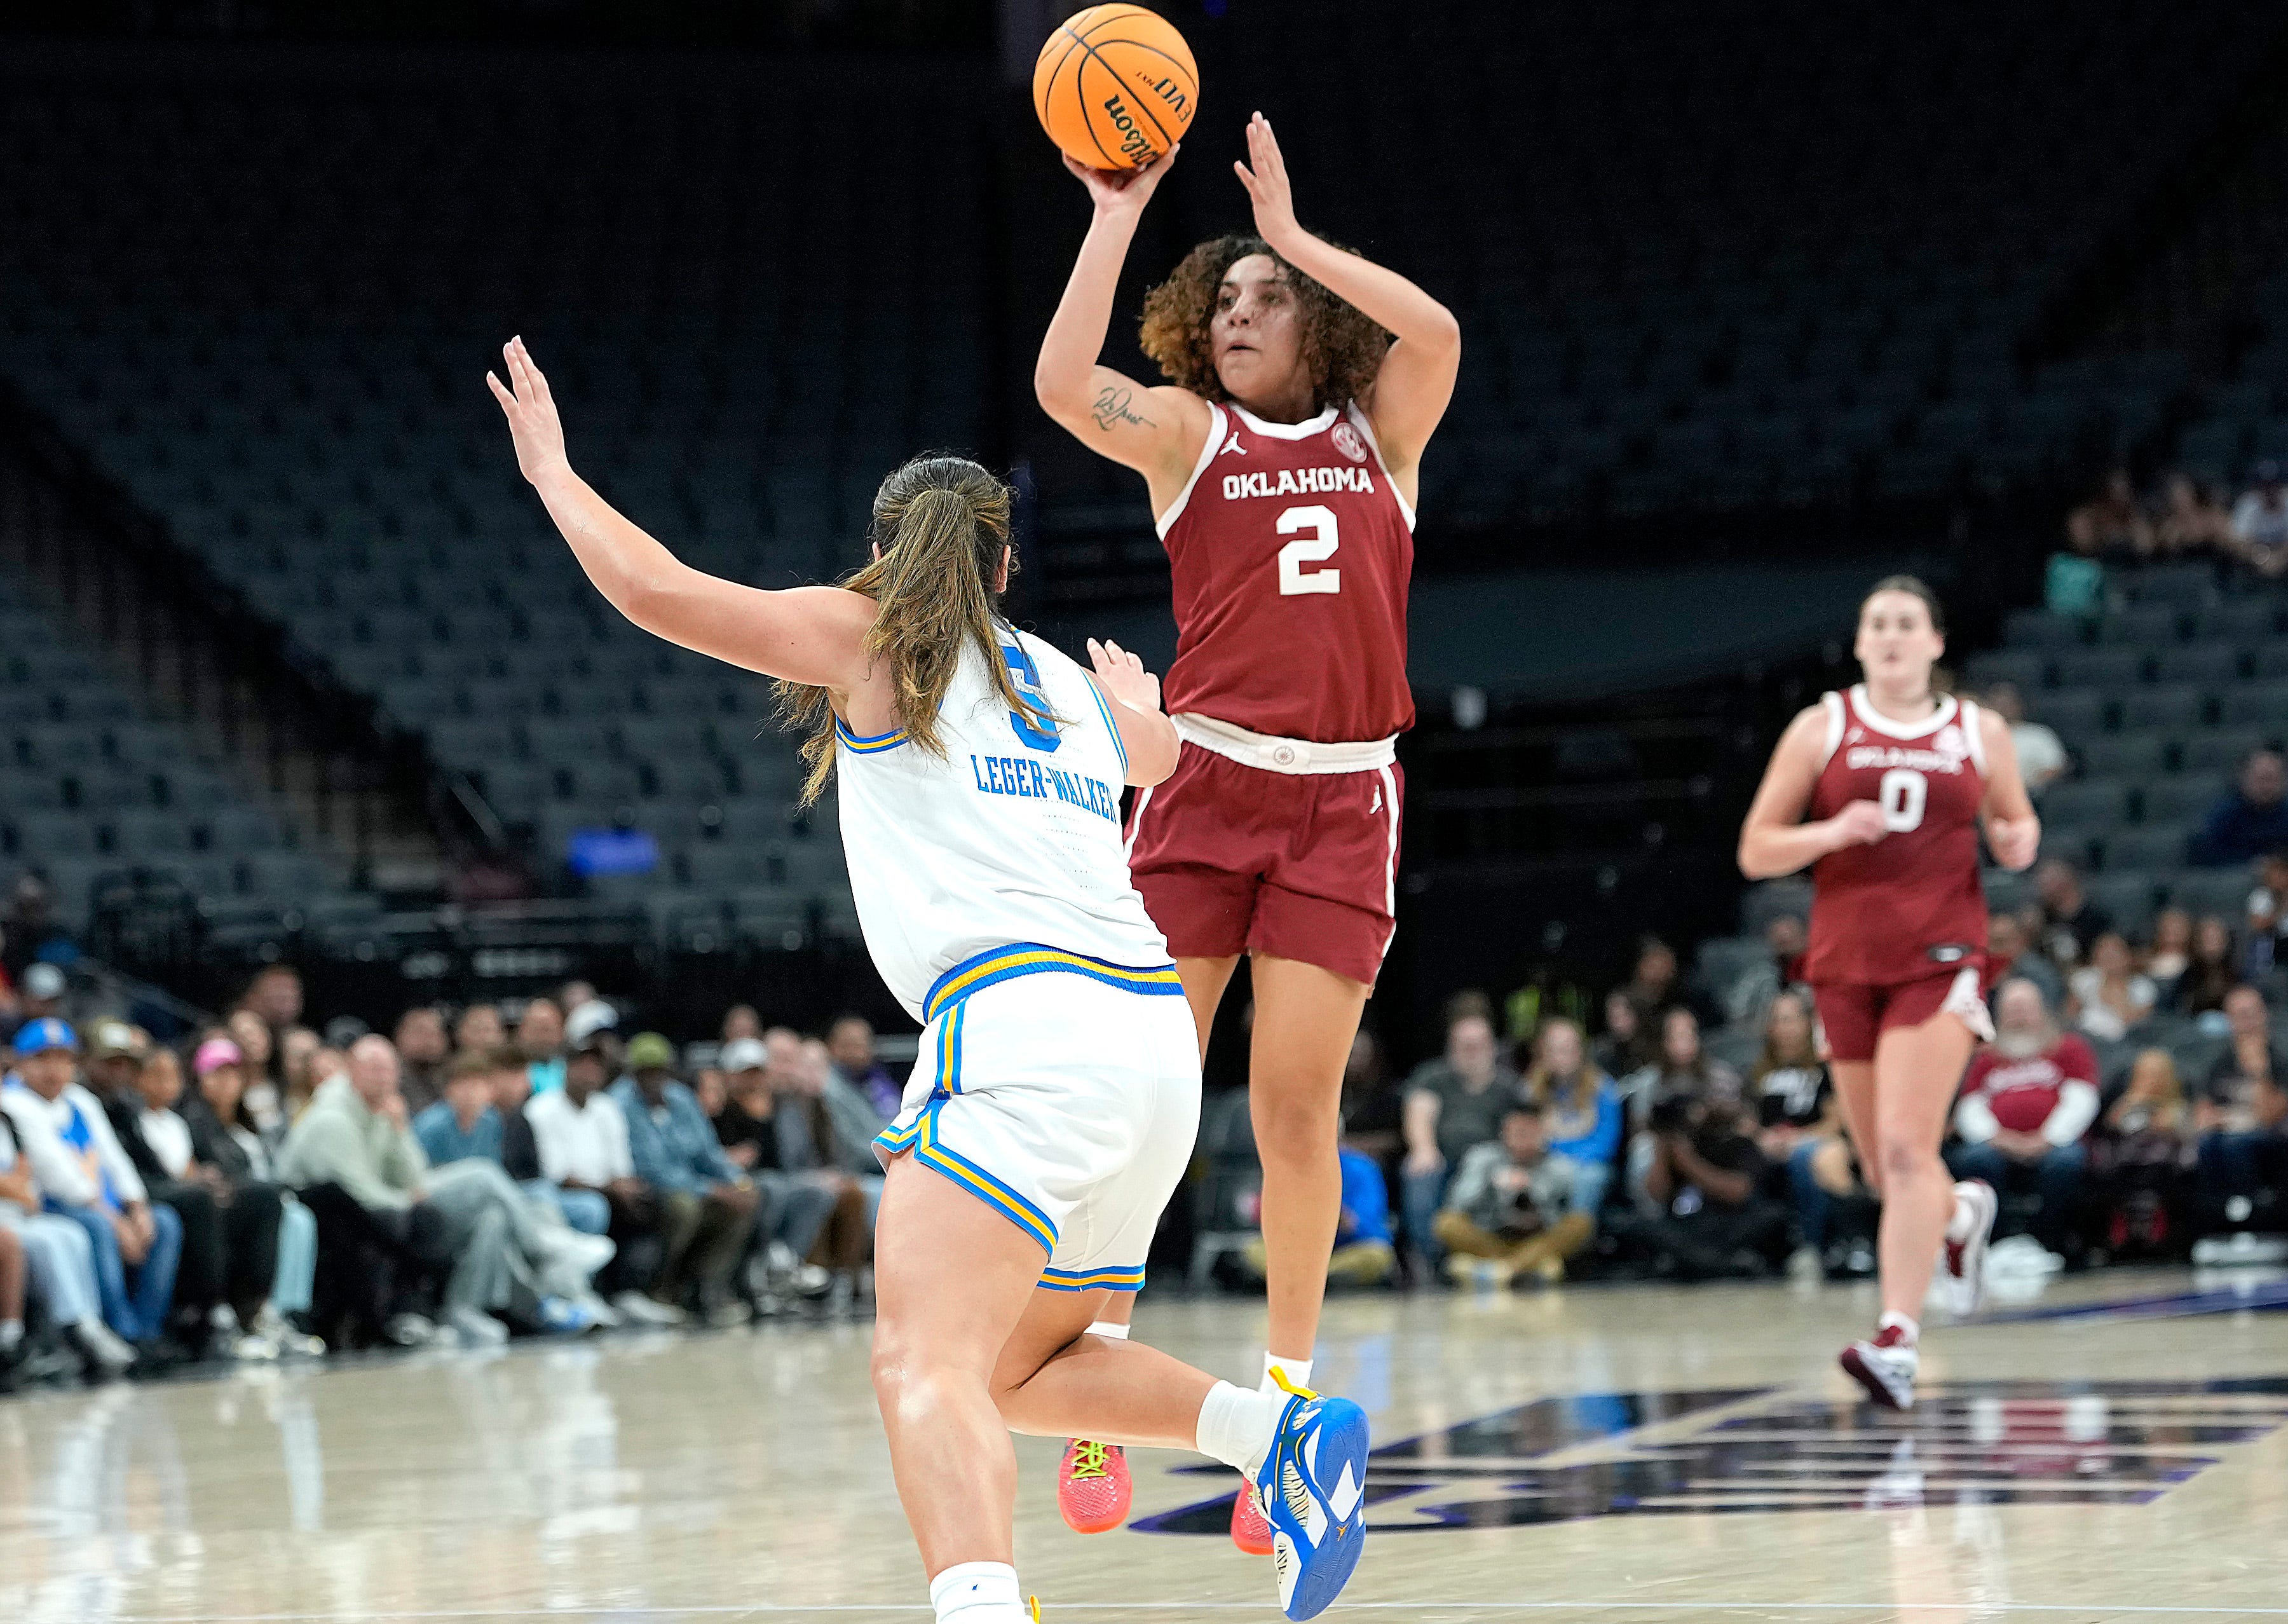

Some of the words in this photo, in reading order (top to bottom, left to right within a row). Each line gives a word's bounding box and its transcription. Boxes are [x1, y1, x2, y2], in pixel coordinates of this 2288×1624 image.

[1223, 467, 1375, 500] OKLAHOMA
[1276, 505, 1340, 596] 2
[1879, 768, 1929, 833] 0
